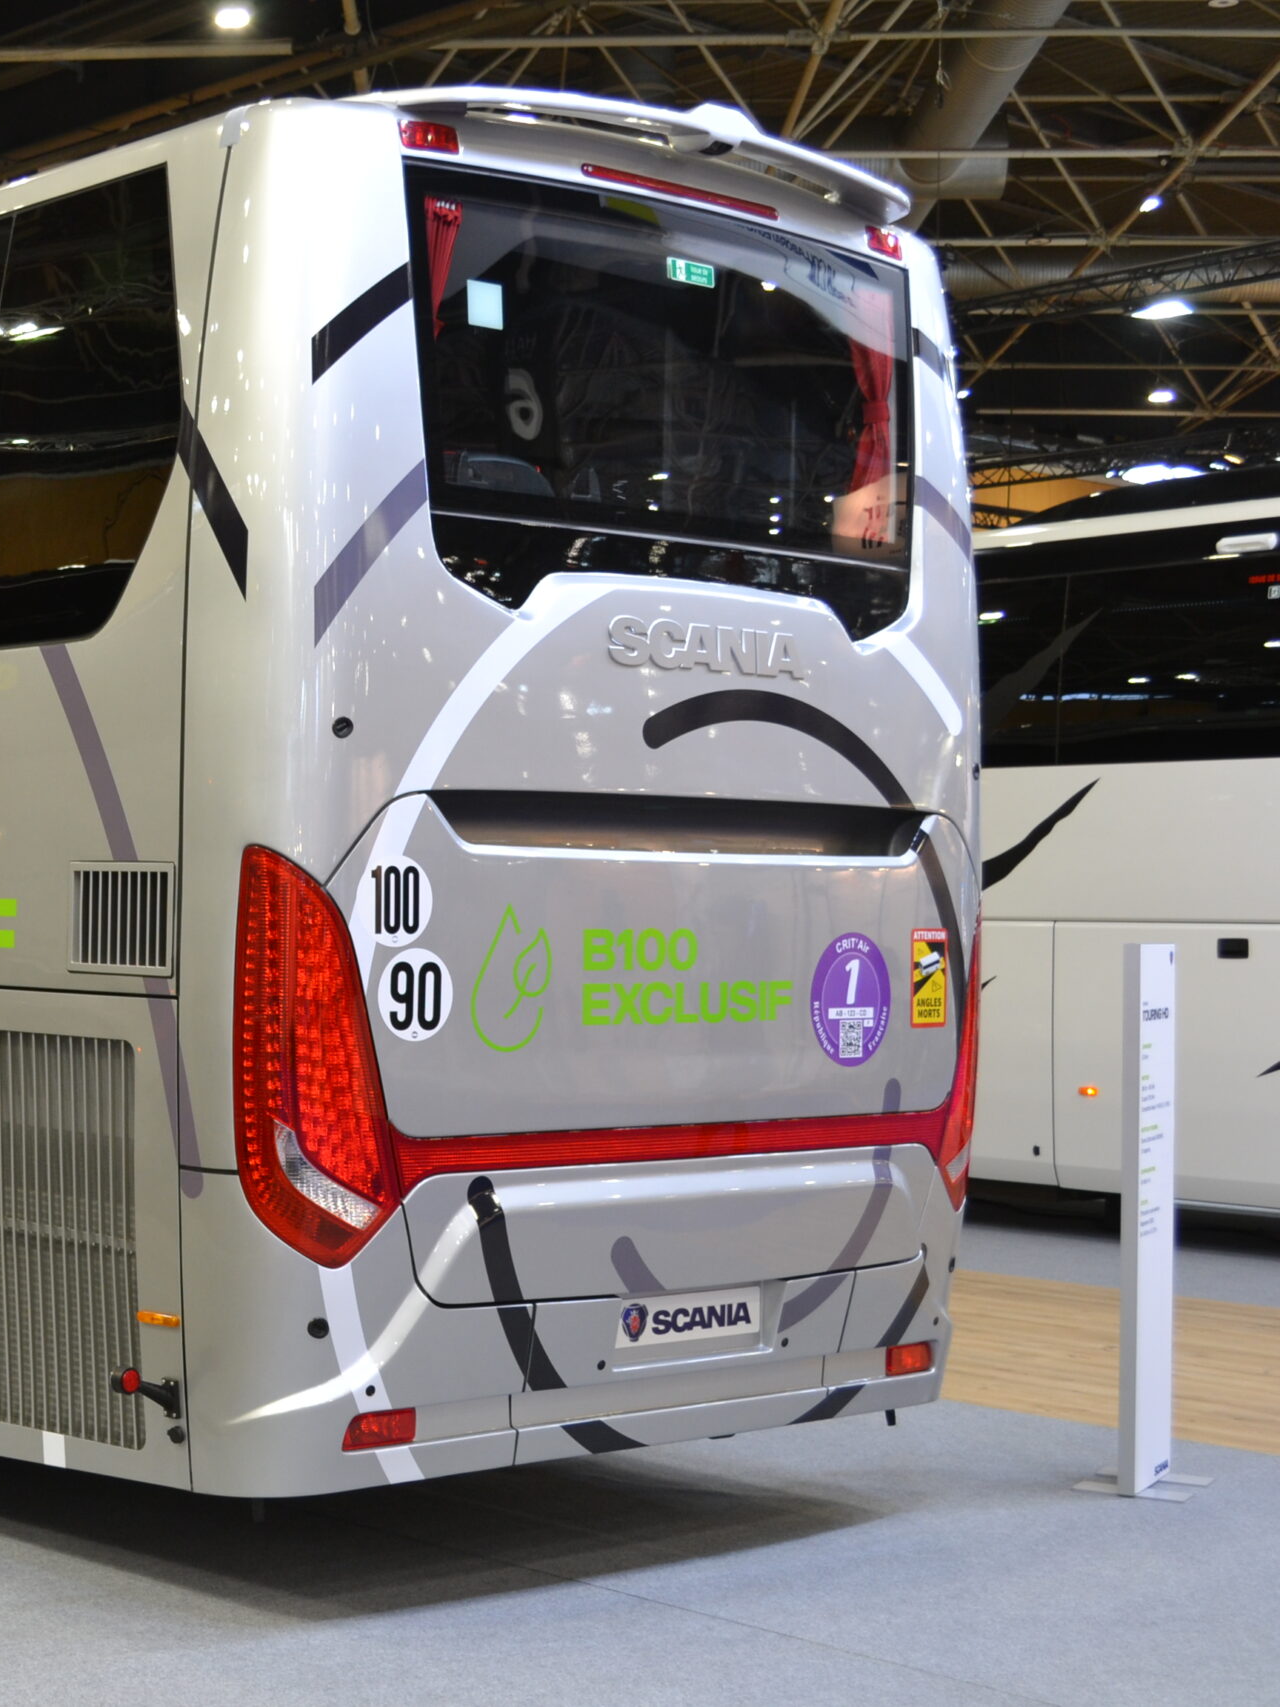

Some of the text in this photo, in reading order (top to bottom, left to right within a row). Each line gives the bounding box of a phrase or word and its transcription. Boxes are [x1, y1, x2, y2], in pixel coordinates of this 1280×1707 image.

[608, 614, 804, 680] SCANIA
[371, 865, 420, 935] 100
[582, 927, 697, 971] B100
[913, 930, 947, 941] ATTENTION
[389, 961, 442, 1031] 90
[582, 980, 792, 1026] EXCLUSIF
[845, 958, 860, 1005] 1
[916, 997, 942, 1008] ANGLES
[917, 1008, 941, 1019] MORTS
[651, 1303, 752, 1334] SCANIA
